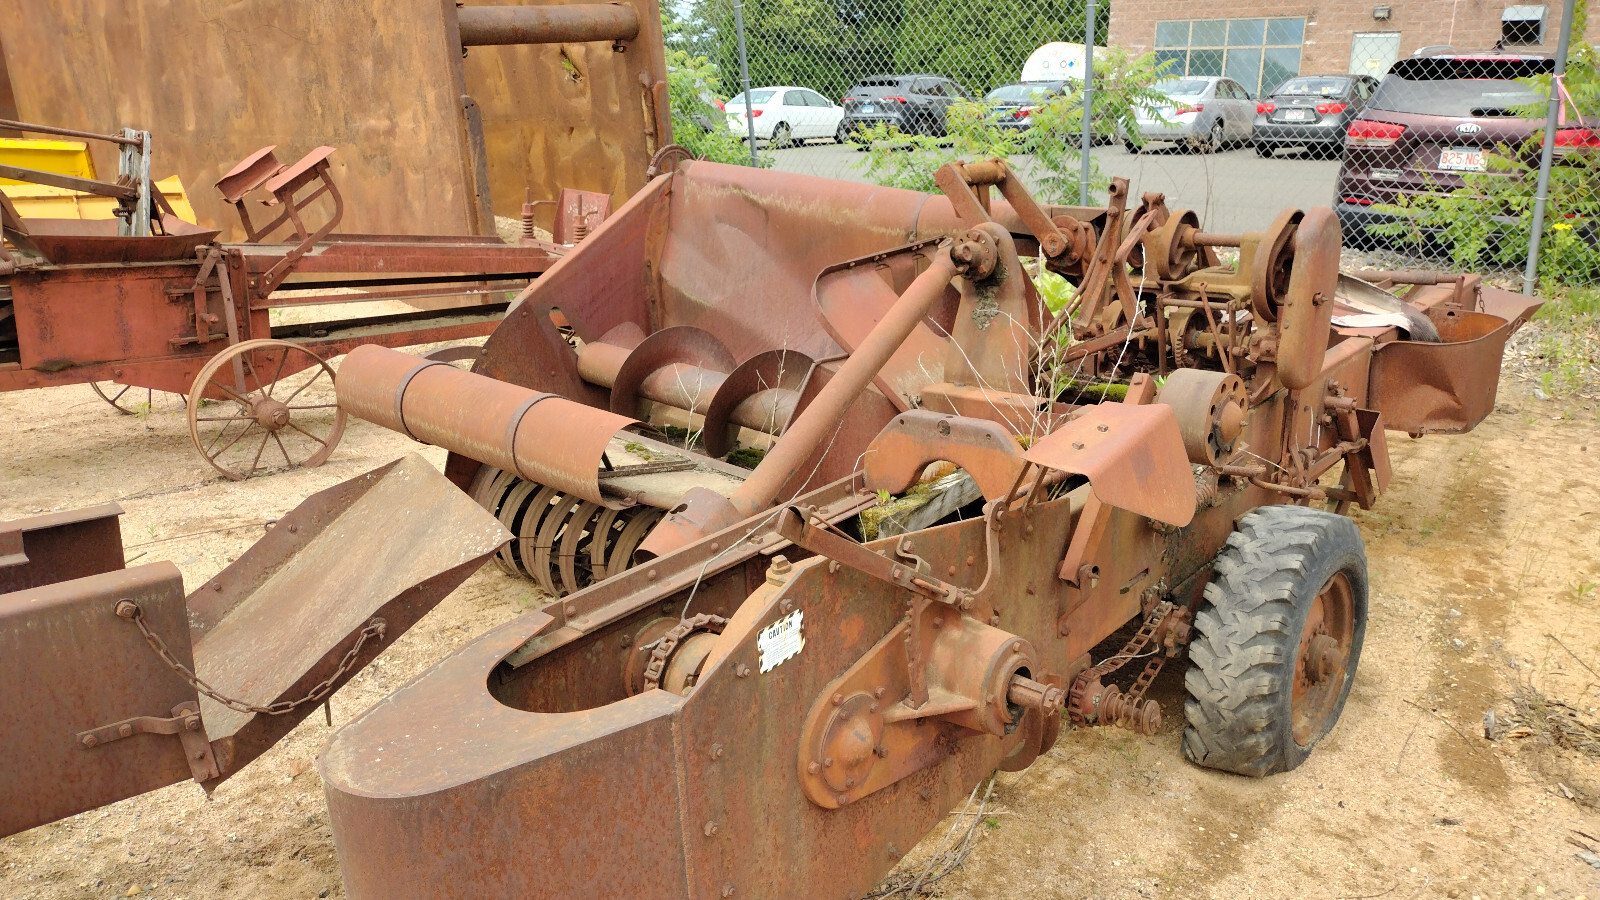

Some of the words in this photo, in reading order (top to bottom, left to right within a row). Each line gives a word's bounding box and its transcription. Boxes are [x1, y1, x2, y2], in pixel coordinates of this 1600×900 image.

[1458, 124, 1478, 133] KIA
[1441, 152, 1463, 165] 825
[768, 620, 793, 640] CAUTION
